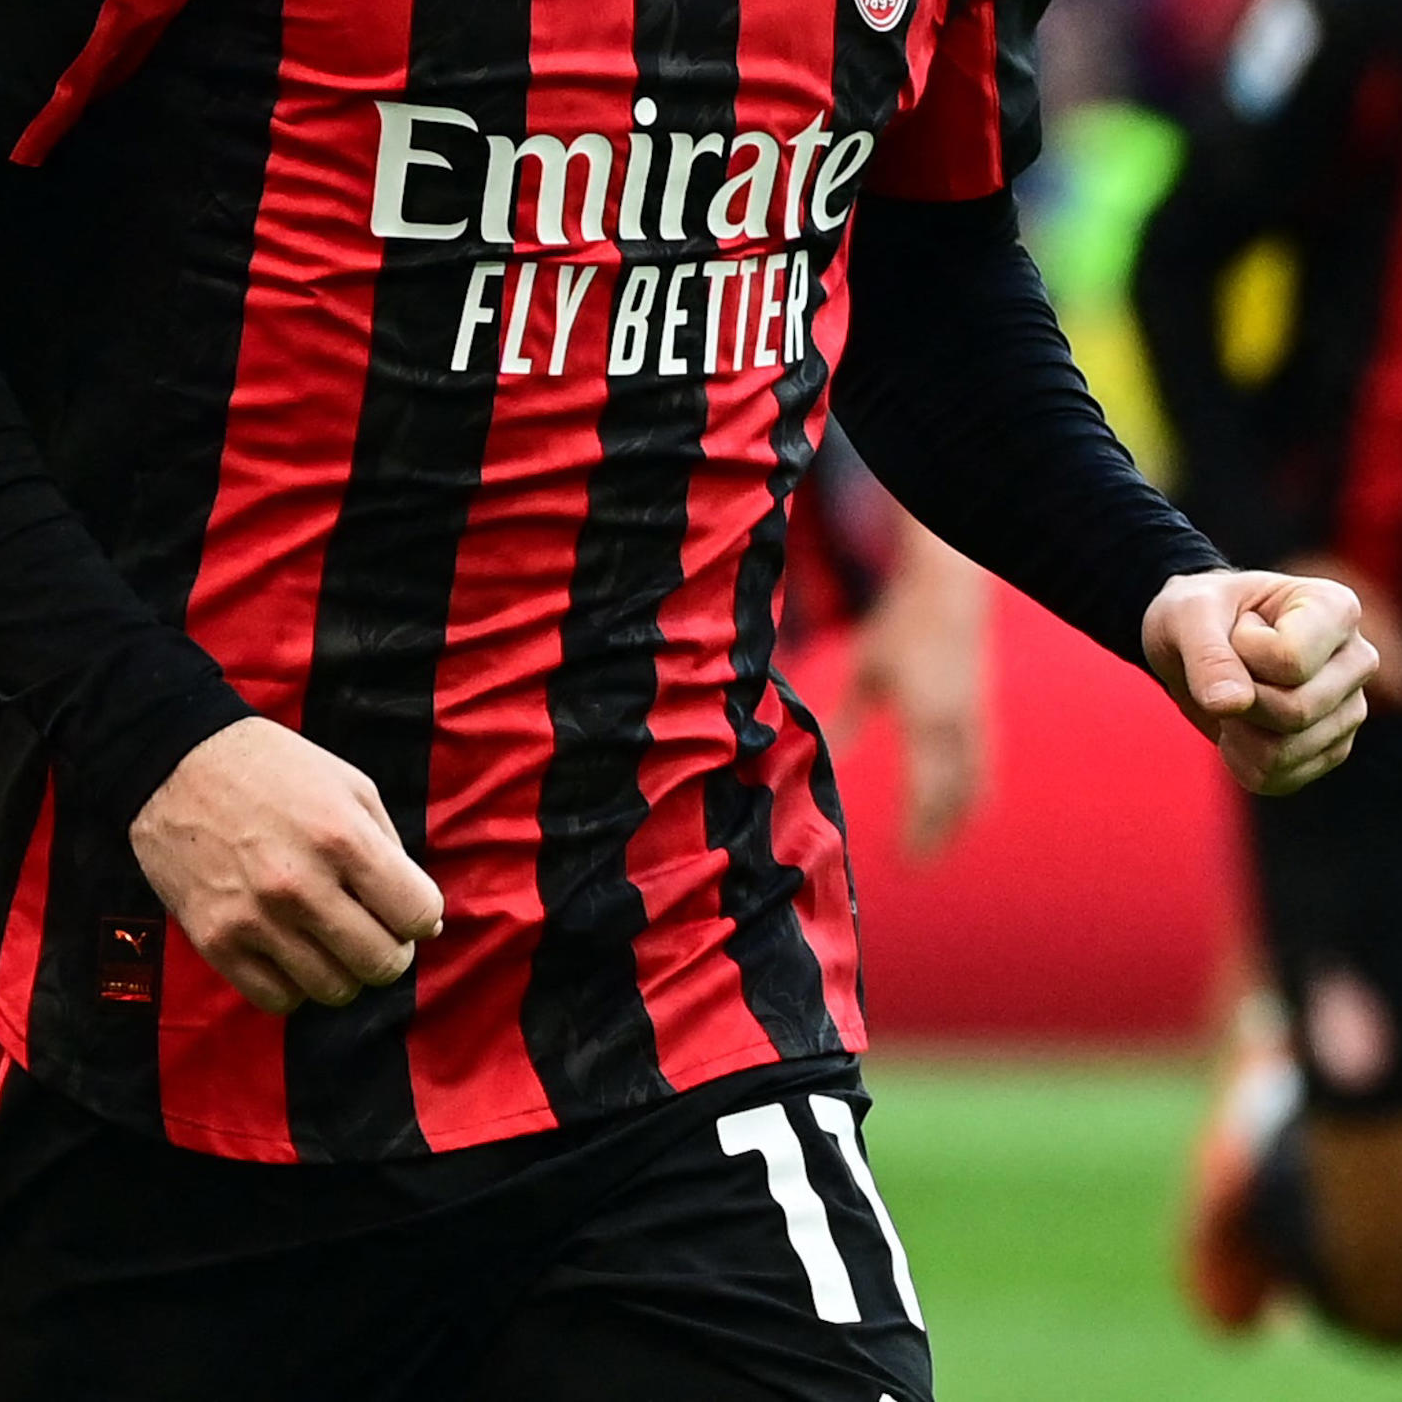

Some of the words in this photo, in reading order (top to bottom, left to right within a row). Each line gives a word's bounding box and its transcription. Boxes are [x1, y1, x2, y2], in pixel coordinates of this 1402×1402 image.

[370, 96, 875, 246] Emirate
[449, 261, 598, 376] FLY
[607, 249, 810, 376] BETTER
[715, 1093, 927, 1333] 11
